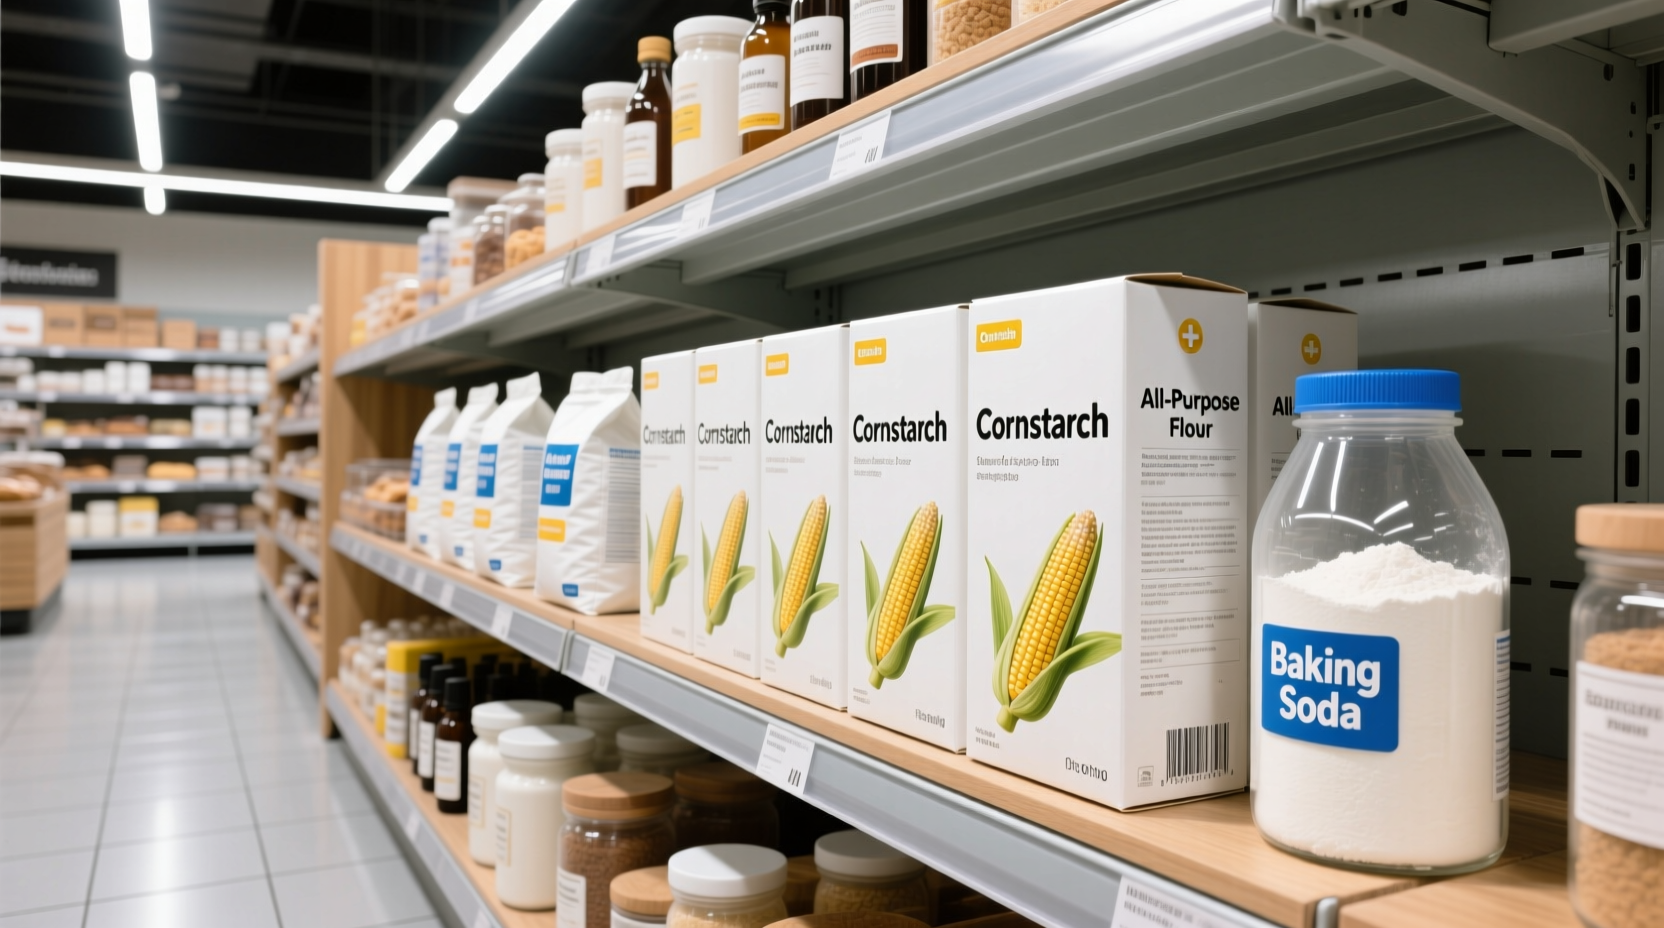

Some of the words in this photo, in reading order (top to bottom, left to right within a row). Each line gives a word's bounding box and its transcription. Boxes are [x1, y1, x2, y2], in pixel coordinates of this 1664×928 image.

[1141, 388, 1240, 416] All-Purpose
[1272, 395, 1294, 416] All
[697, 420, 751, 445] Cornstarch
[765, 415, 833, 443] Cornstarch
[853, 410, 947, 442] Cornstarch
[976, 401, 1109, 440] Cornstarch
[1169, 416, 1214, 438] Flour
[1270, 640, 1381, 699] Baking
[1279, 684, 1362, 731] Soda
